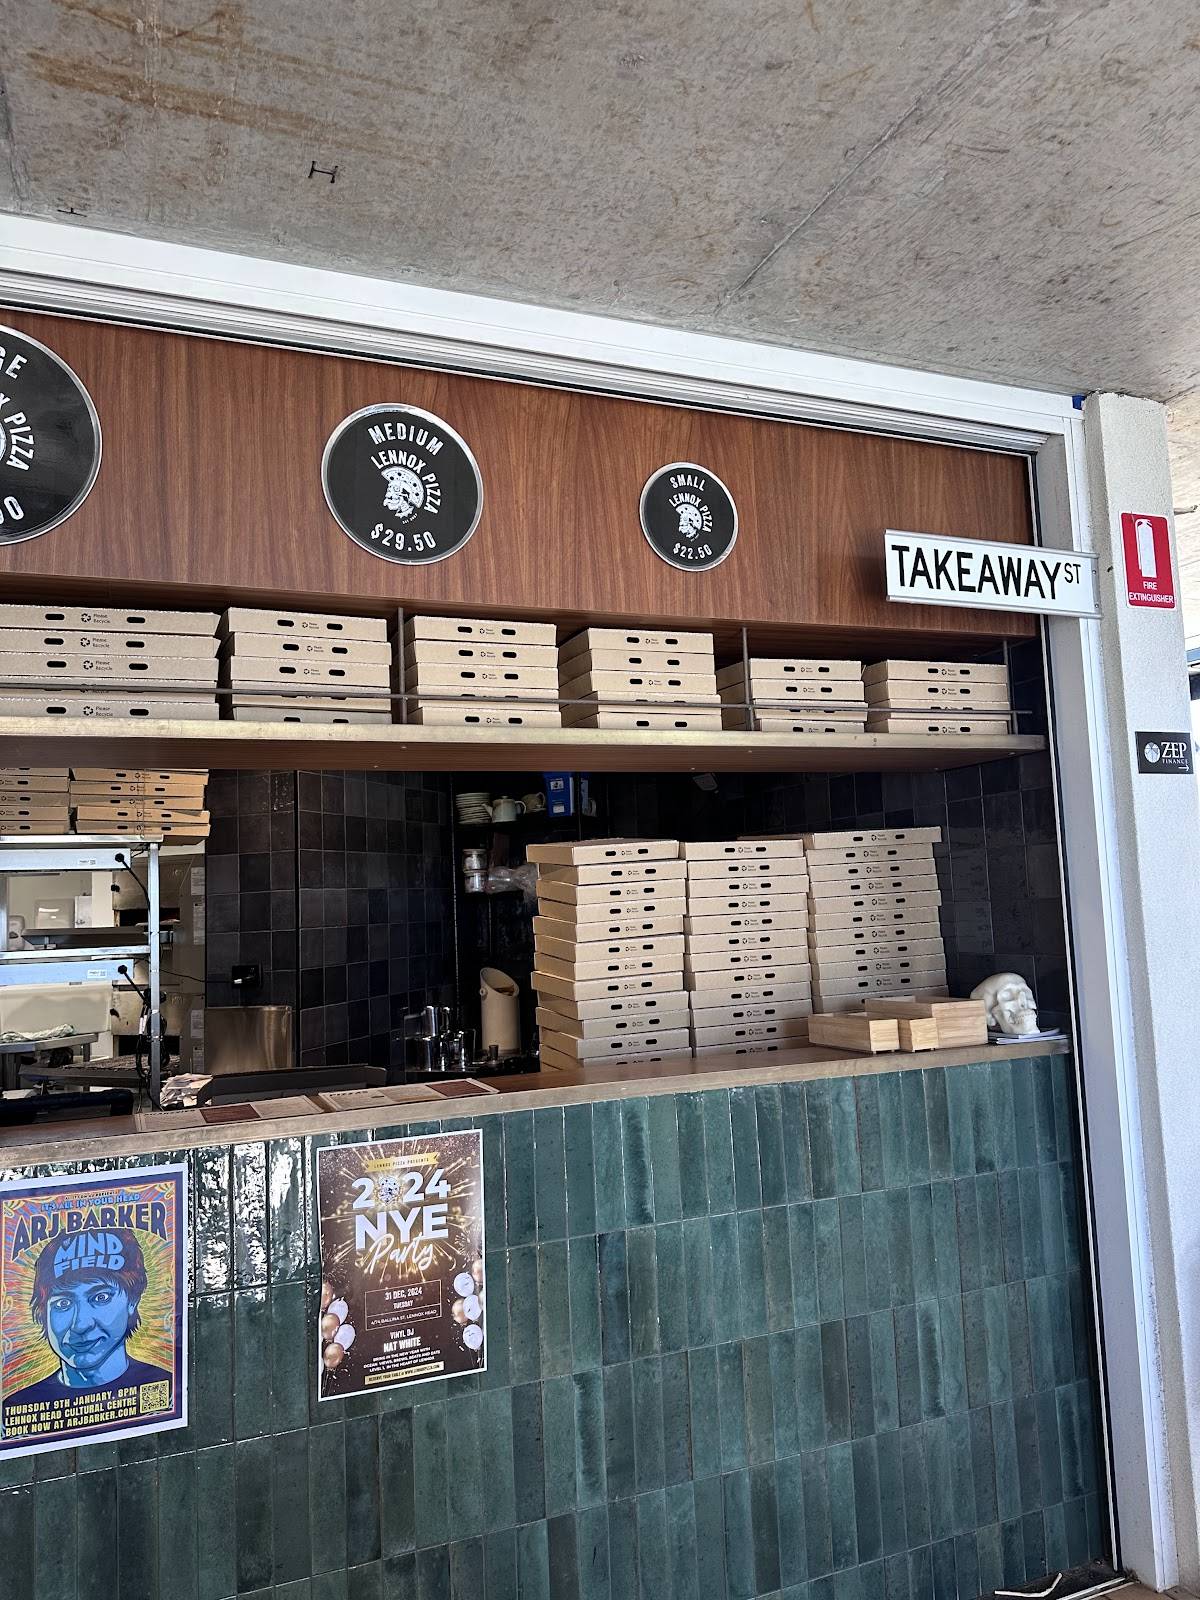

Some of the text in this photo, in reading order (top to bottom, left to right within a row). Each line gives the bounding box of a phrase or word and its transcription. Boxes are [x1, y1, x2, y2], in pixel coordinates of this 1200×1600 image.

[4, 412, 34, 471] PIZZA
[367, 422, 444, 455] MEDIUM
[371, 450, 441, 514] LENNOX PIZZA
[669, 474, 705, 491] SMALL
[668, 493, 713, 532] LENNOX PIZZA
[371, 523, 436, 552] $29.50
[673, 543, 712, 559] $22.50
[891, 545, 1081, 600] TAKEAWAY ST
[1142, 581, 1158, 590] FIRE
[1129, 592, 1175, 604] EXTINGUISHER
[1160, 742, 1187, 758] ZEP
[76, 1198, 87, 1208] IN
[88, 1196, 114, 1206] YOUR
[117, 1193, 141, 1203] HEAD
[351, 1168, 451, 1209] 2024
[11, 1201, 168, 1262] ARJ BARKER
[355, 1203, 449, 1251] NYE
[54, 1231, 124, 1263] MIND
[364, 1233, 434, 1274] Party
[54, 1254, 125, 1278] FIELD
[385, 1292, 392, 1301] 31
[407, 1286, 423, 1297] 2024
[393, 1299, 414, 1309] TUESDAY
[381, 1316, 399, 1324] BALLINA
[407, 1311, 425, 1319] LENNOX
[425, 1309, 437, 1317] HEAD
[390, 1328, 415, 1340] VINYL DJ
[399, 1336, 422, 1350] WHITE
[400, 1360, 413, 1368] HEART
[419, 1355, 435, 1363] LENNOX
[5, 1402, 51, 1416] THURSDAY
[54, 1399, 70, 1409] 9TH
[118, 1386, 138, 1397] 8PM
[5, 1397, 137, 1427] LENNOX HEAD CULTURAL CENTRE
[5, 1407, 137, 1437] BOOK NOW AT ARJBARKER.COM
